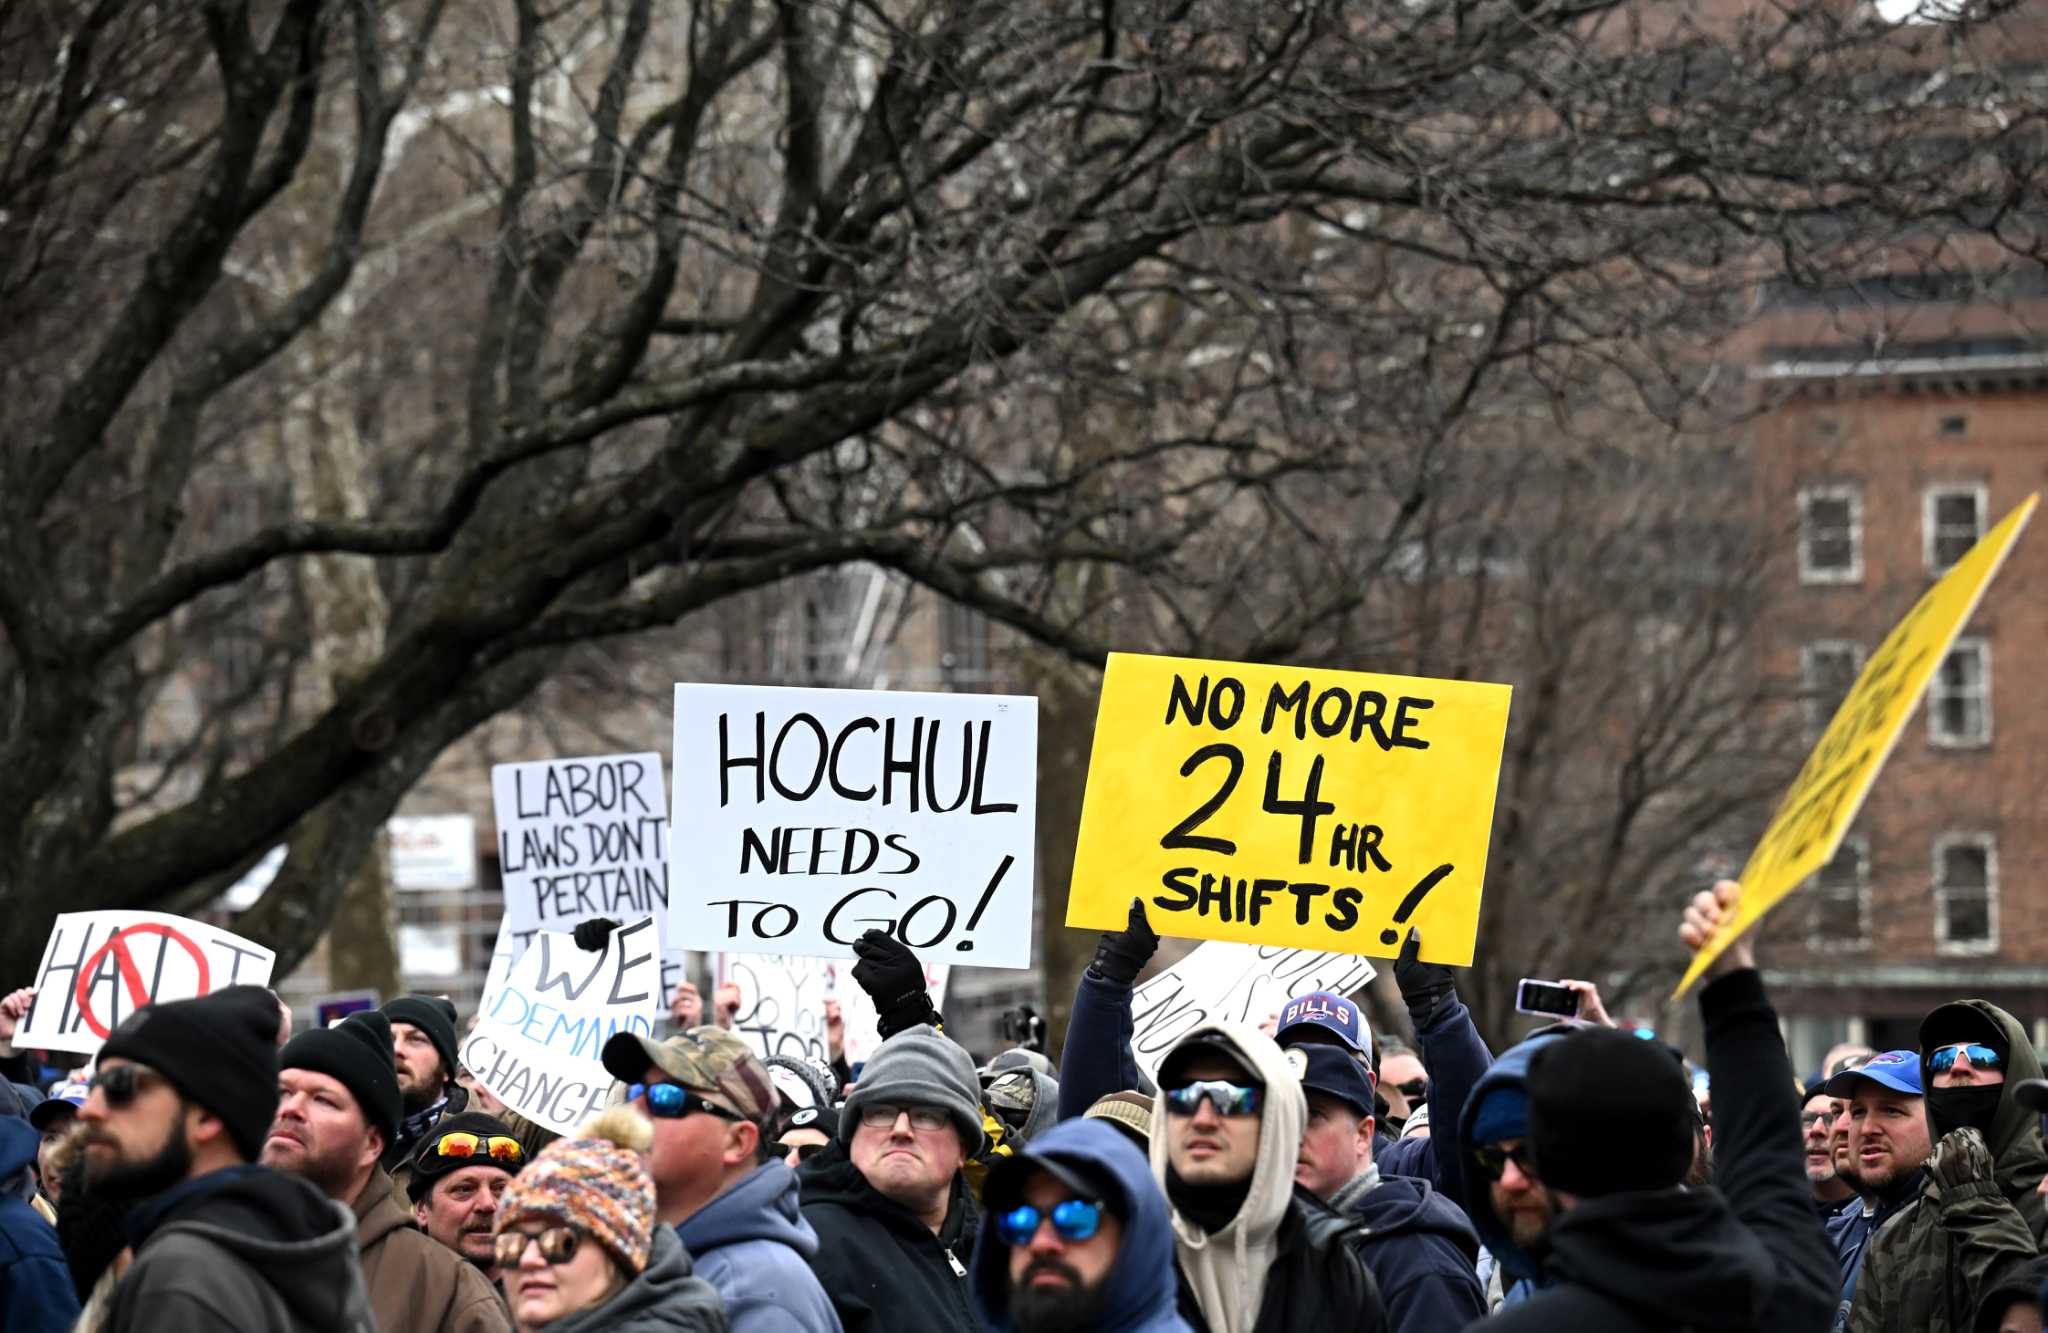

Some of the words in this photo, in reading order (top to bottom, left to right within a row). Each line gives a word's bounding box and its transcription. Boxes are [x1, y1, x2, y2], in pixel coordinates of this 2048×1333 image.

[1165, 673, 1246, 731] NO
[1261, 680, 1435, 751] MORE
[516, 760, 650, 820] LABOR
[718, 711, 1019, 815] HOCHUL
[502, 824, 579, 873] LAWS
[740, 826, 921, 876] NEEDS
[531, 862, 669, 920] PERTAIN
[706, 899, 800, 939] TO
[823, 855, 1015, 951] GO!
[535, 916, 653, 1005] WE
[1286, 999, 1351, 1025] BILLS
